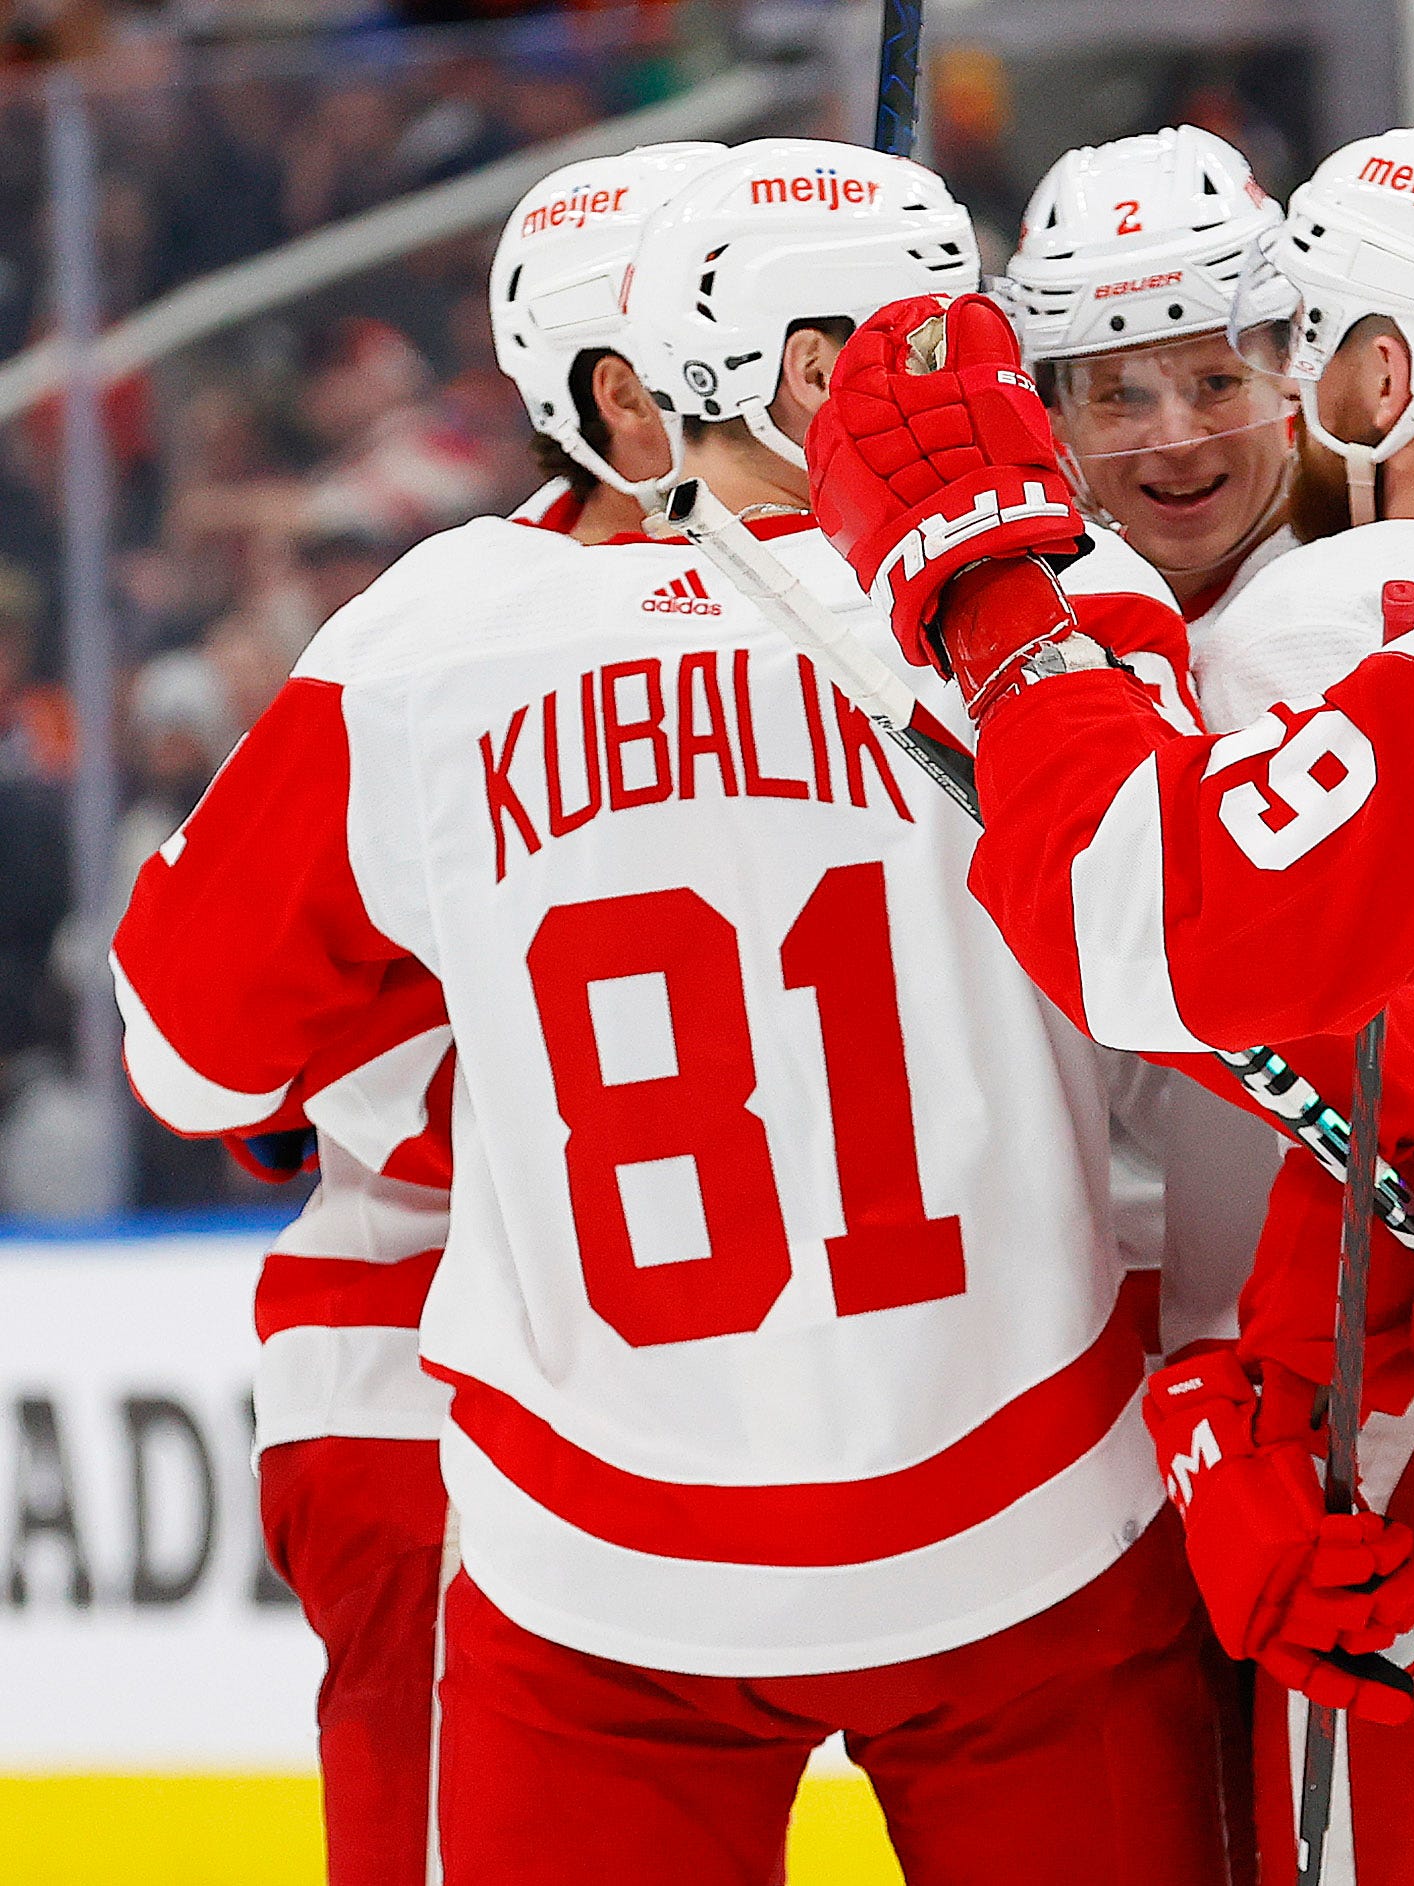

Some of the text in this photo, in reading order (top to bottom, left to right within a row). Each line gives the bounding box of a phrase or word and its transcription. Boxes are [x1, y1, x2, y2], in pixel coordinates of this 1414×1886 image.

[521, 184, 630, 238] meijer
[751, 168, 880, 211] meijer
[1114, 200, 1142, 236] 2
[1094, 270, 1183, 299] BAUER
[641, 596, 722, 617] adidas
[478, 648, 916, 885] KUBALIK
[526, 860, 967, 1349] 81
